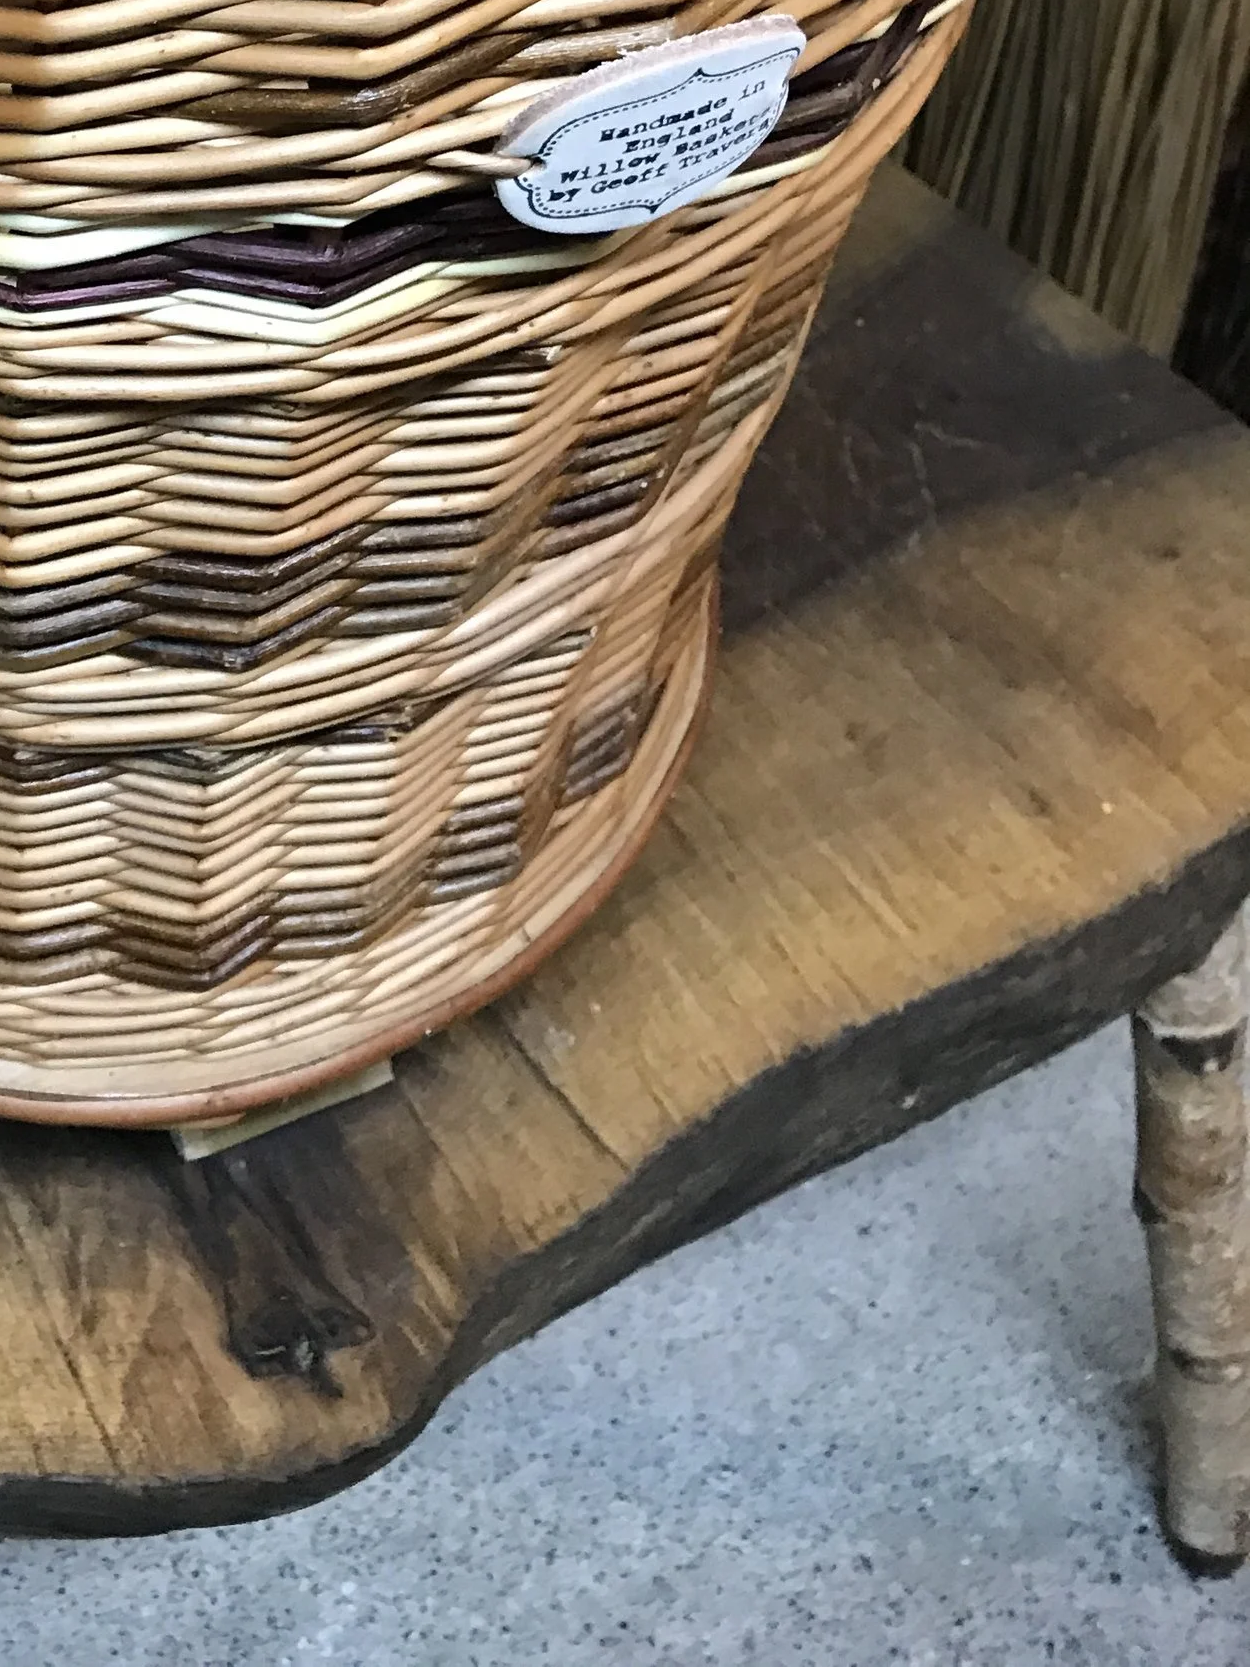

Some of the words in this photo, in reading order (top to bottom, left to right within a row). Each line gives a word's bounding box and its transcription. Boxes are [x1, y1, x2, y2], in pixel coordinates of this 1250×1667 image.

[599, 96, 727, 142] Handmade
[739, 80, 765, 100] in
[622, 109, 733, 154] England
[548, 188, 582, 203] by
[591, 162, 667, 194] Geoff
[679, 118, 769, 169] Travers
[560, 153, 658, 183] Willow
